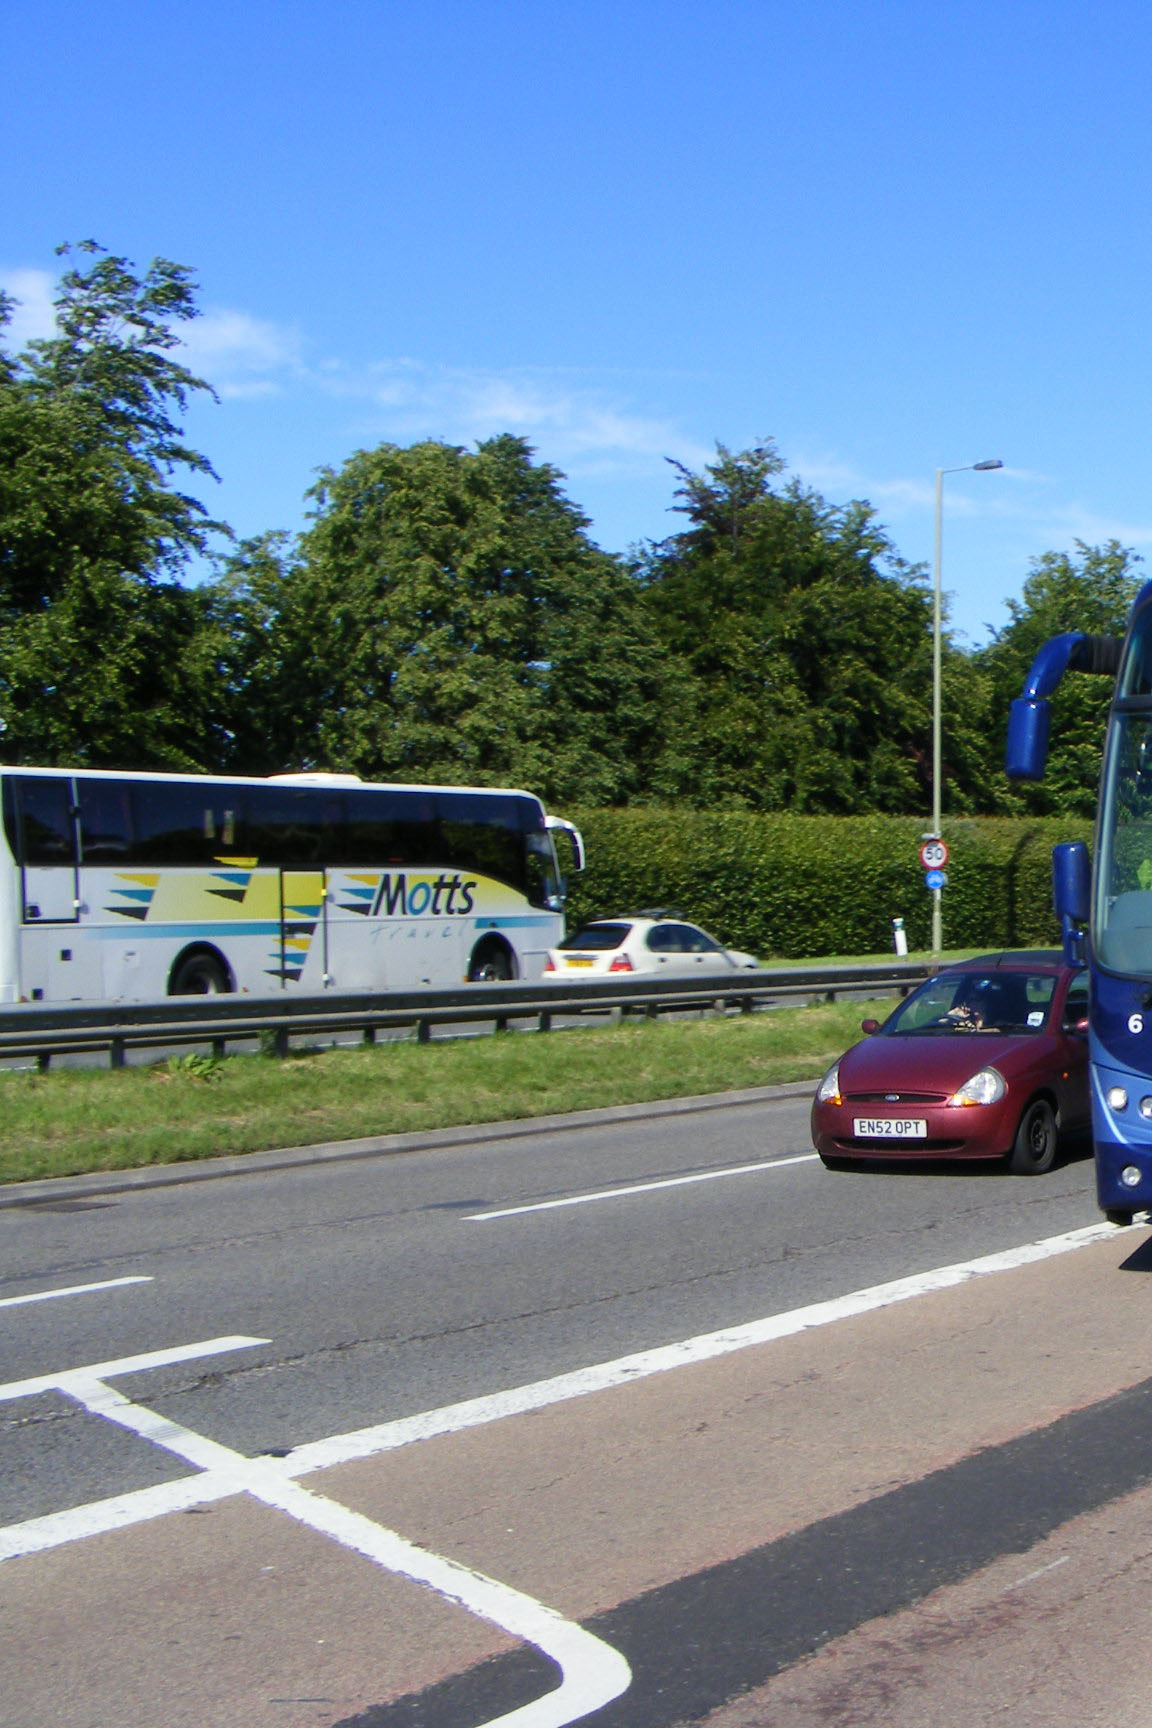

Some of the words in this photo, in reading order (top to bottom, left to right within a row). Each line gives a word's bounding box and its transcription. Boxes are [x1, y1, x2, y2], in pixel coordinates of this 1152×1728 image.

[926, 847, 944, 860] 50
[372, 874, 477, 916] Motts
[1128, 1014, 1143, 1034] 6
[859, 1121, 892, 1134] EN52
[895, 1121, 920, 1134] OPT
